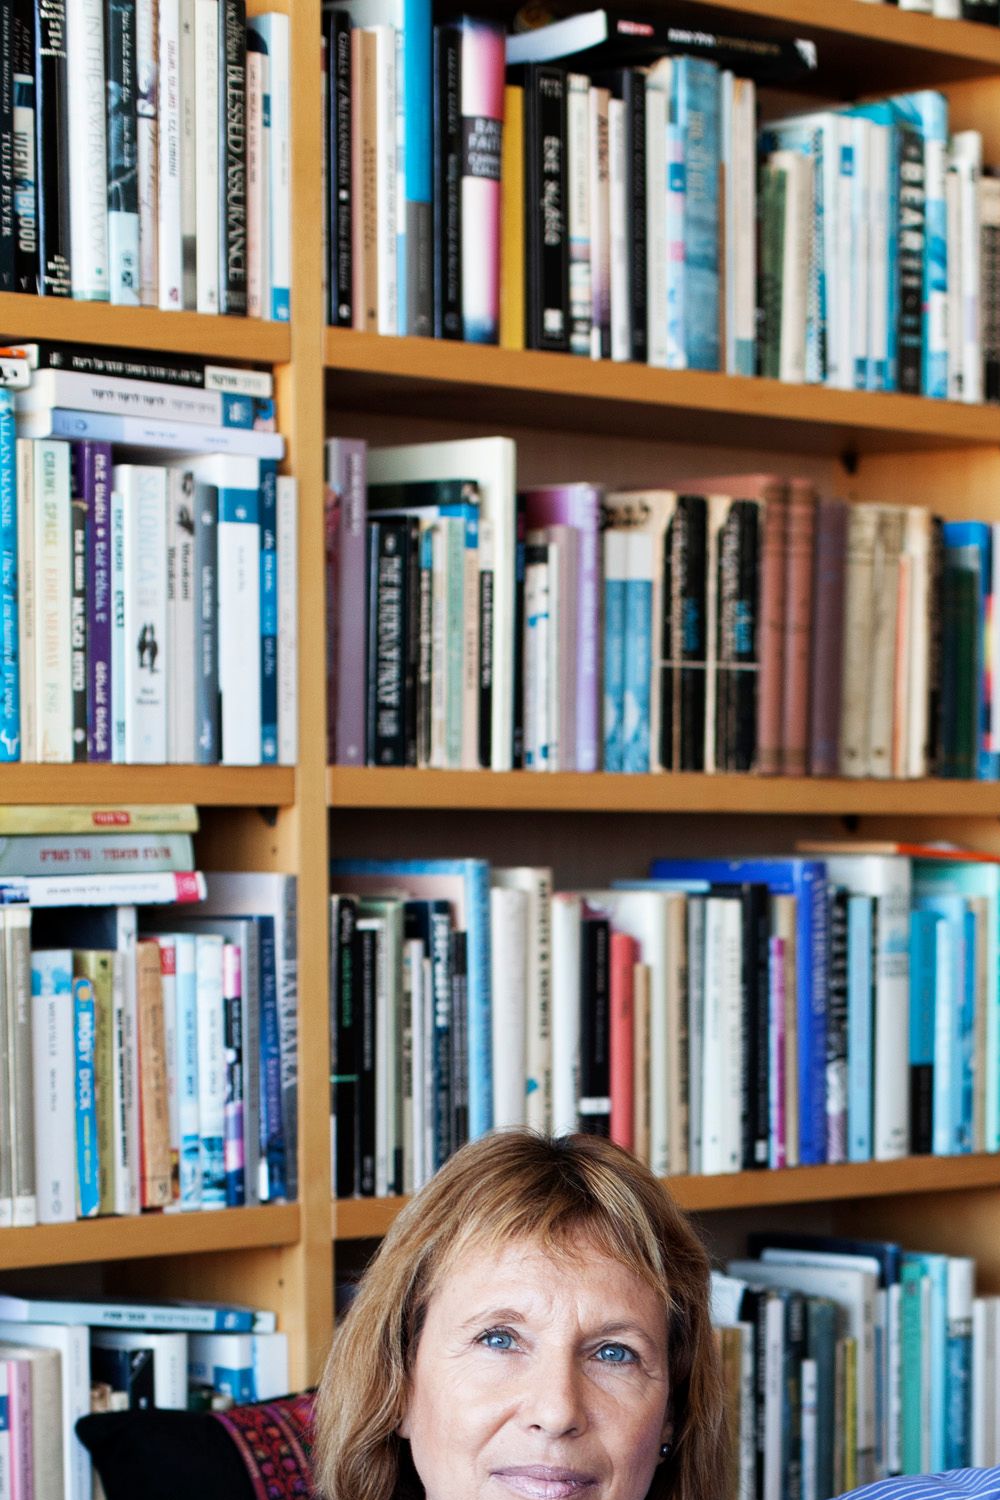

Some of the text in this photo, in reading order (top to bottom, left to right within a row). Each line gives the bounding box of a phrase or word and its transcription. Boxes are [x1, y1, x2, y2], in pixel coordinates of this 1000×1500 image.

[1, 132, 12, 237] TULIP FEVER
[14, 131, 36, 253] VIENNA BLOOD
[226, 64, 245, 281] BLESSED ASSURANCE
[1, 409, 13, 527] ALLAN MASSIE
[43, 450, 57, 547] CRAWL SPACE
[95, 454, 106, 481] נגיב
[136, 475, 160, 583] SALONICA
[181, 543, 191, 600] Murakami
[78, 1010, 93, 1063] MOBY
[281, 960, 297, 1090] BARBARA
[79, 1068, 93, 1110] DICK
